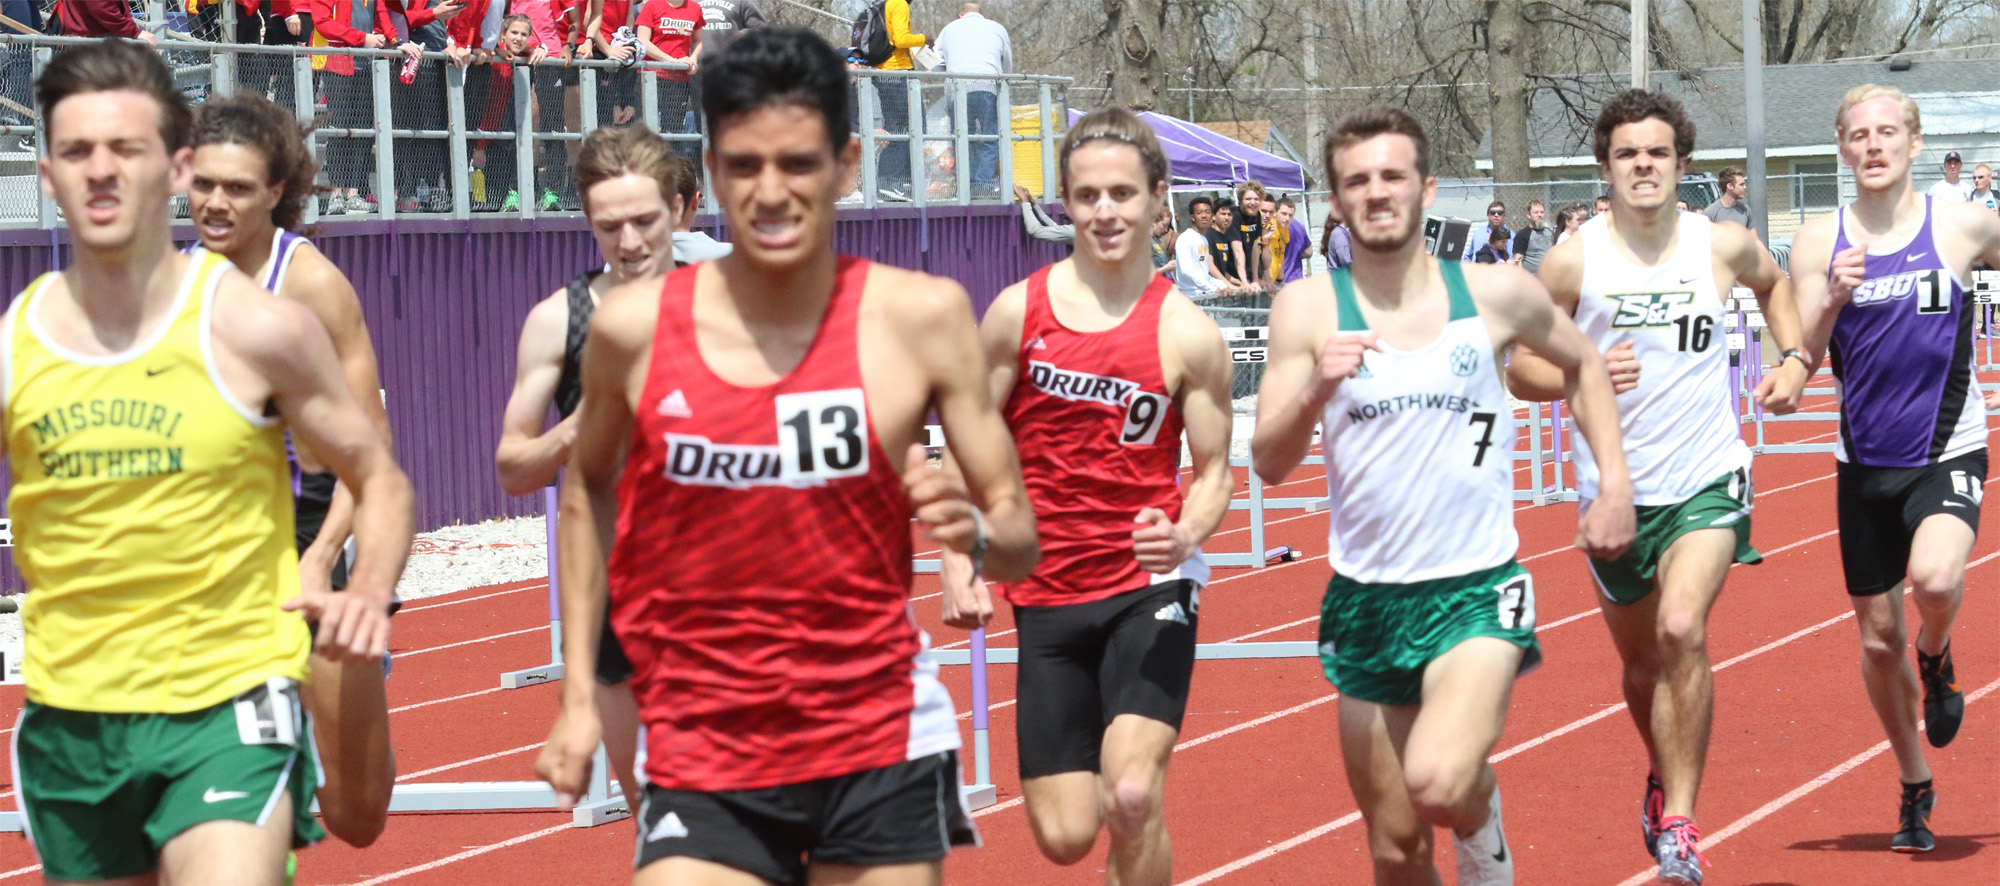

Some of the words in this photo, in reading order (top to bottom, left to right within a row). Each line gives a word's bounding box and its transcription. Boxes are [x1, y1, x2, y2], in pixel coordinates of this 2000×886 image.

[662, 18, 693, 29] DRURY
[1853, 271, 1917, 306] SBU
[1919, 269, 1948, 313] 1
[1606, 291, 1694, 328] S&T
[1673, 314, 1714, 353] 16
[1032, 365, 1132, 402] DRURY
[31, 399, 183, 444] MISSOURI
[1123, 394, 1158, 442] 9
[1347, 393, 1481, 424] NORTHWES
[783, 405, 862, 472] 13
[1468, 412, 1497, 467] 7
[39, 447, 183, 478] SOUTHERN
[1503, 579, 1526, 628] 7
